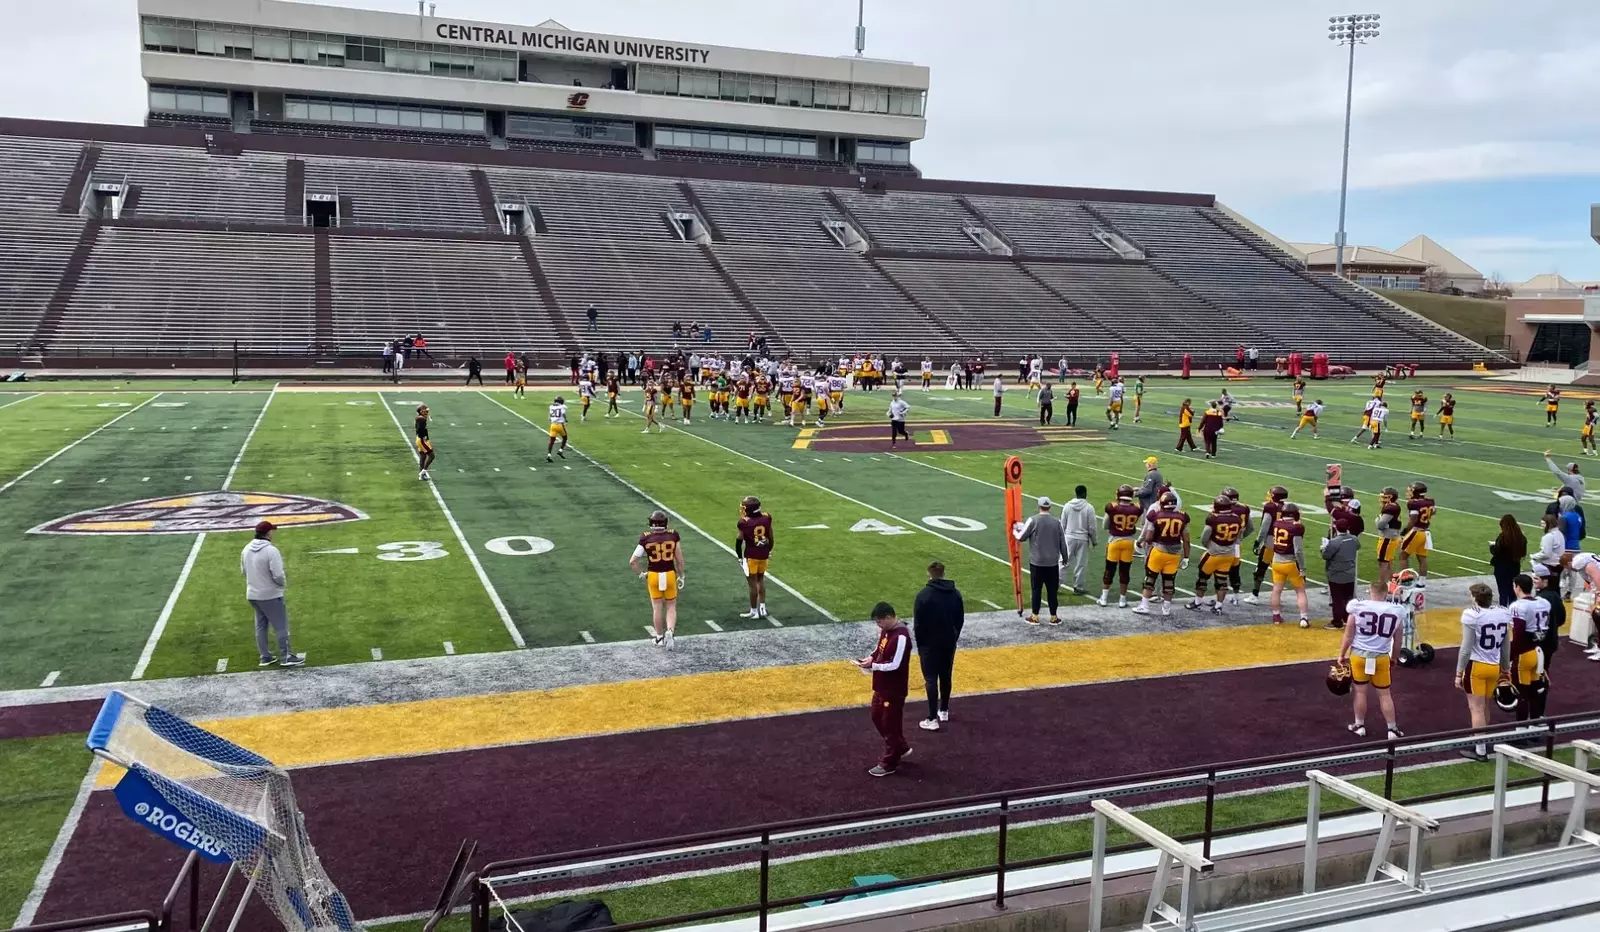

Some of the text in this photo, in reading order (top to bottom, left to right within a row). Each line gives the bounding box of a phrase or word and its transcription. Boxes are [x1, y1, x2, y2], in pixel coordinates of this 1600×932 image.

[436, 23, 710, 63] CENTRAL MICHIGAN UNIVERSITY
[1327, 465, 1341, 486] 2
[1113, 514, 1138, 531] 98
[1156, 518, 1182, 537] 70
[1215, 523, 1240, 541] 92
[753, 525, 766, 542] 8
[1273, 527, 1289, 546] 12
[645, 541, 675, 562] 38
[1359, 611, 1398, 638] 30
[1480, 623, 1508, 650] 63
[146, 807, 225, 857] ROGERS
